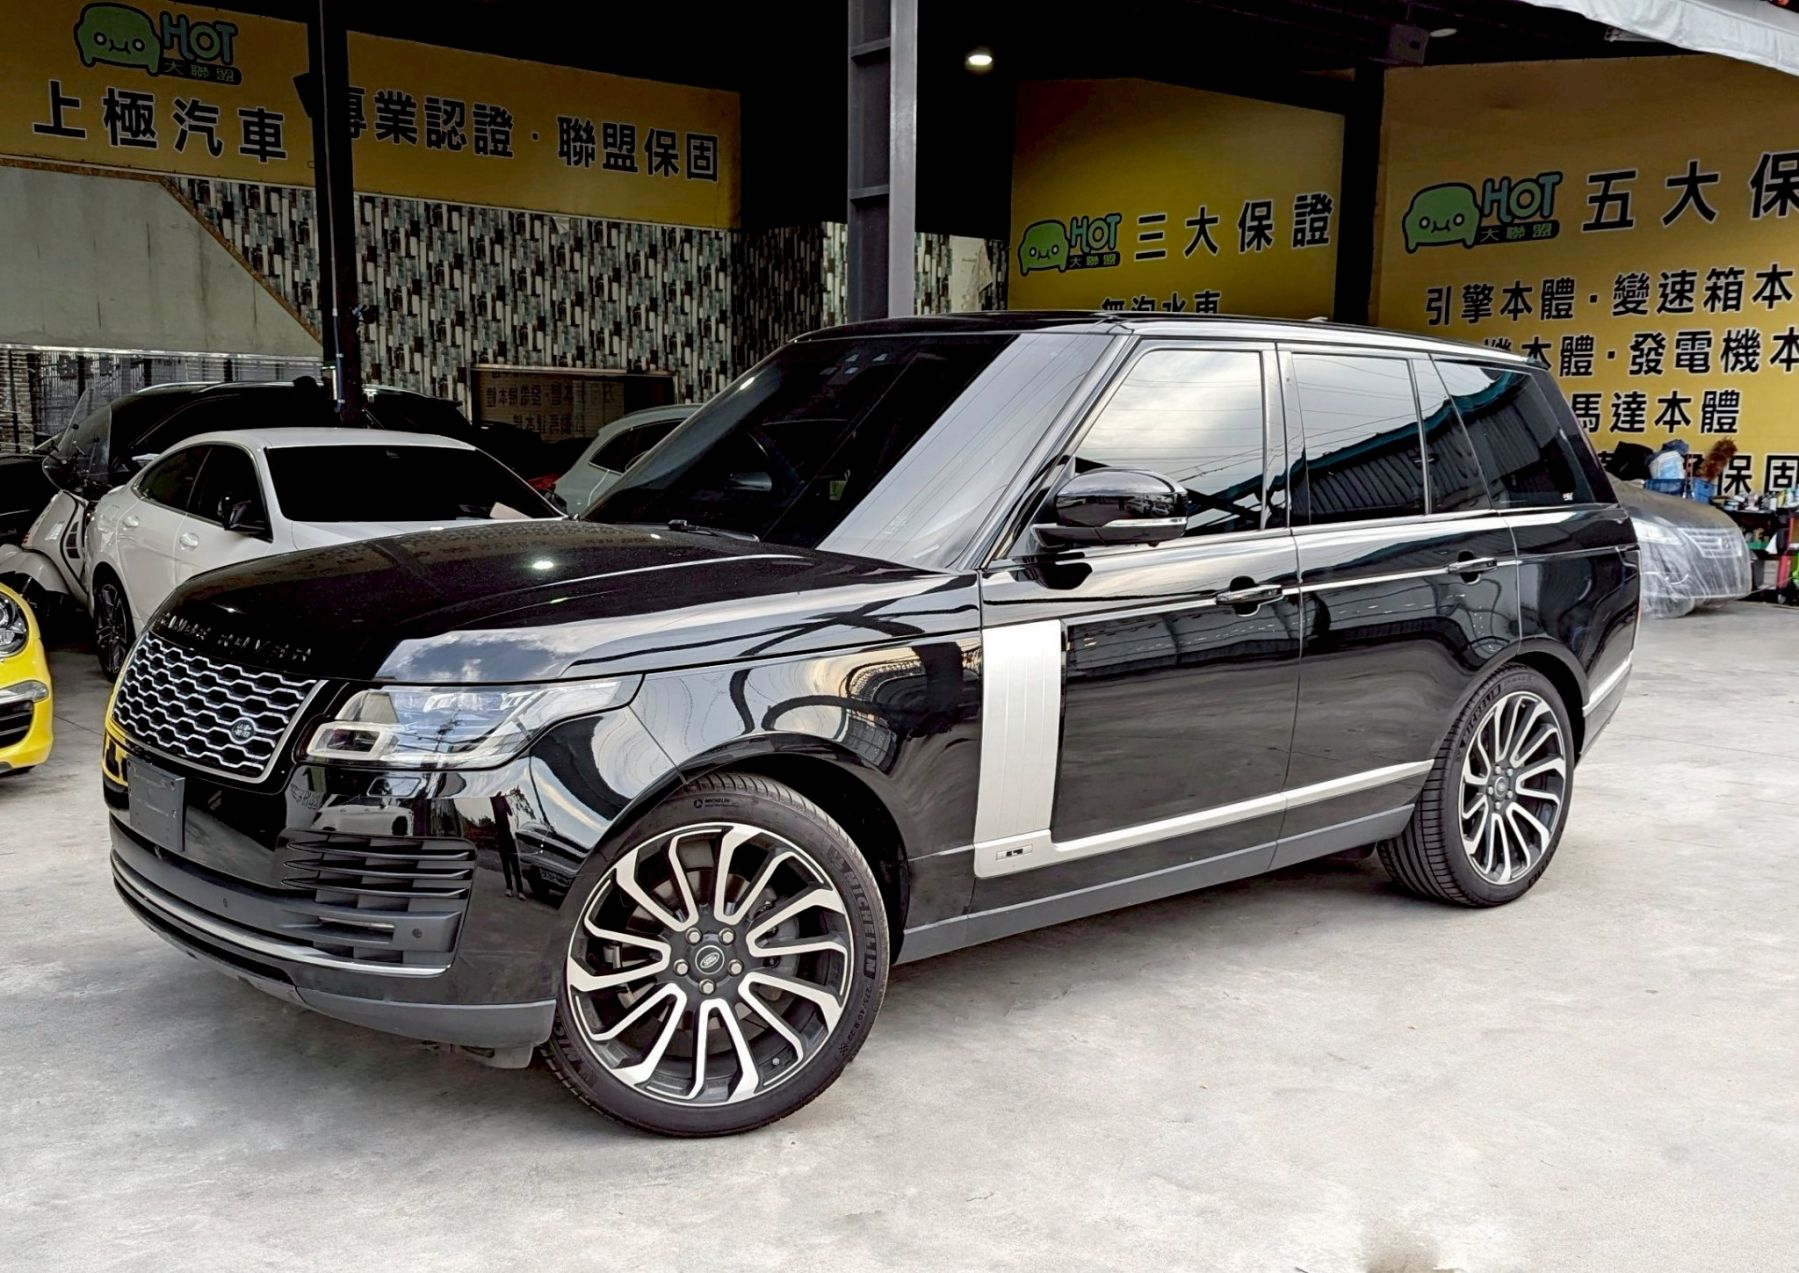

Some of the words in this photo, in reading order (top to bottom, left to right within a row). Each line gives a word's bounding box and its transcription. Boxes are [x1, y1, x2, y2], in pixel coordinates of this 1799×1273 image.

[162, 12, 237, 64] HOT
[164, 60, 235, 82] 大聯盟
[33, 79, 287, 163] 上極汽車
[1482, 171, 1562, 222] HOT
[1581, 151, 1799, 233] 五大保
[1070, 213, 1122, 252] HOT
[1135, 192, 1334, 260] 三大保證
[1480, 223, 1552, 242] 大聯盟
[1069, 253, 1117, 268] 大聯盟
[1571, 389, 1741, 434] 馬達本體
[843, 869, 877, 980] MICHELIN
